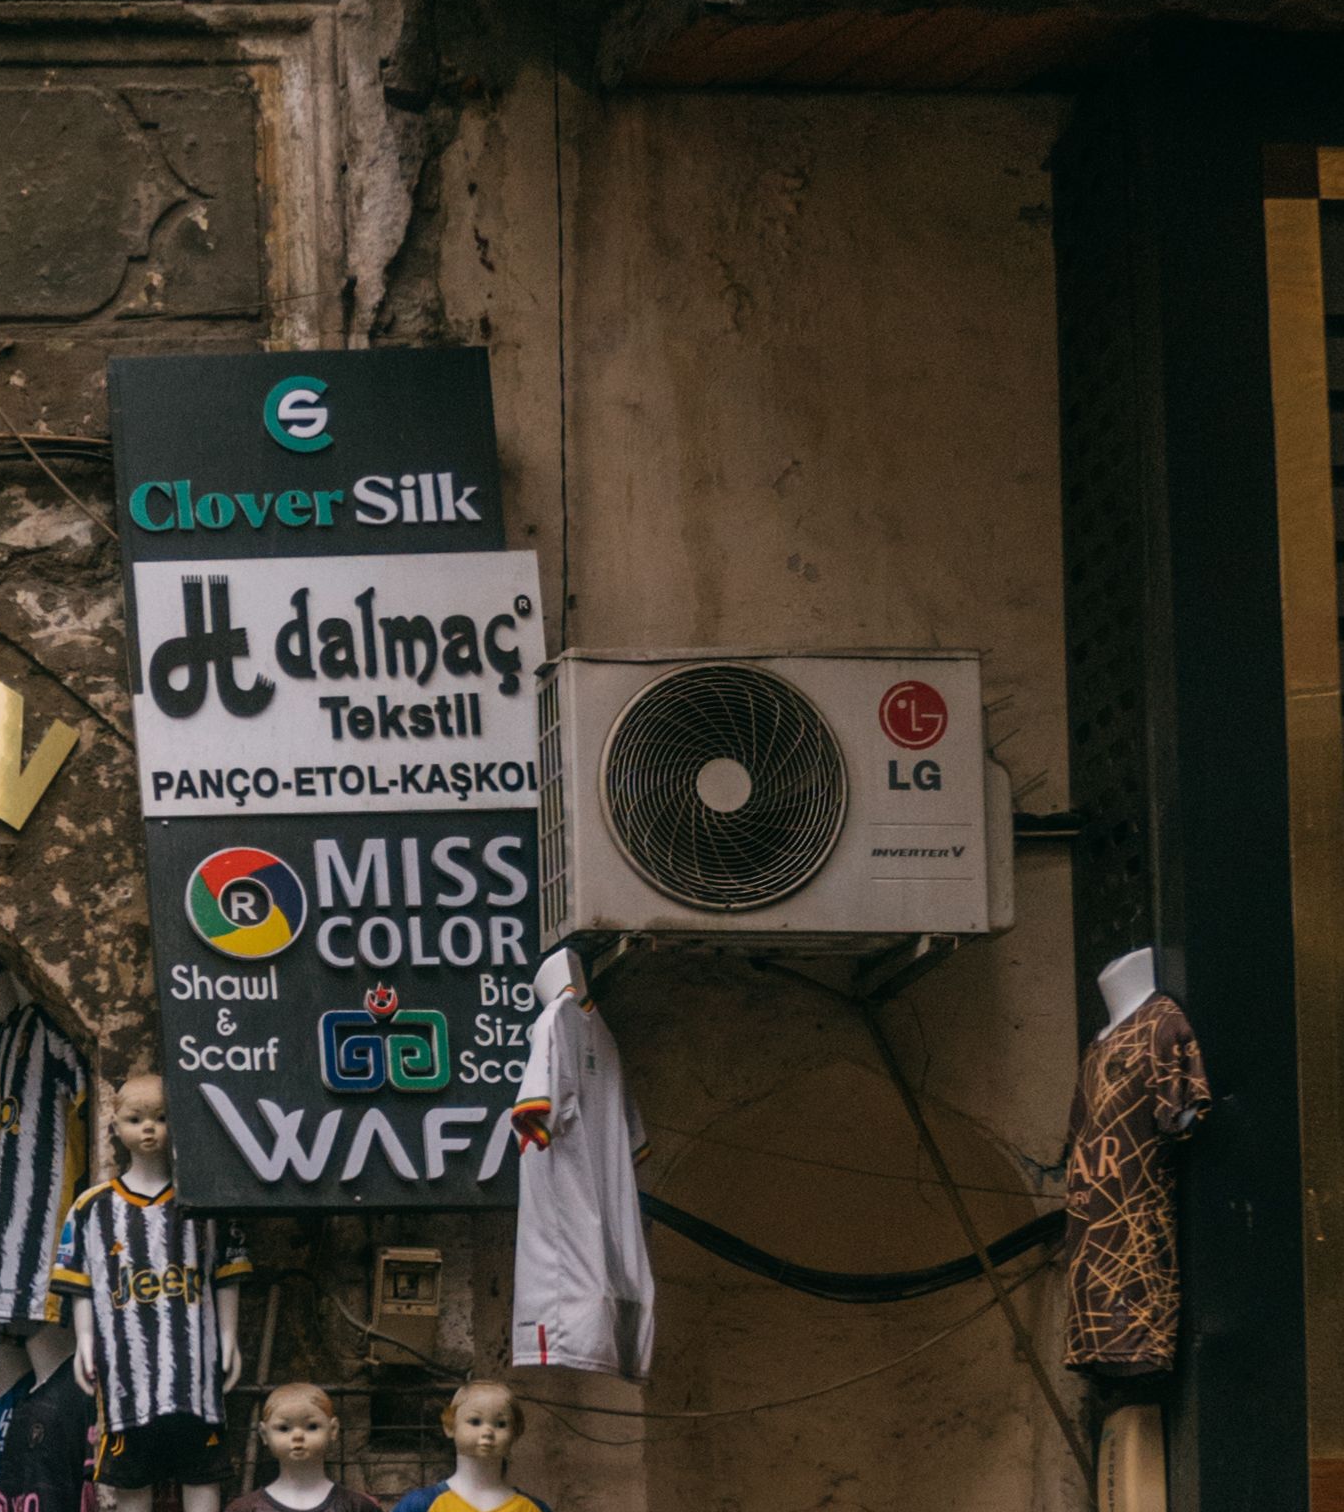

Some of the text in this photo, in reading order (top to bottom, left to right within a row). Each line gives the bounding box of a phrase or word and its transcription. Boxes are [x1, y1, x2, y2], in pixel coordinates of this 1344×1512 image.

[129, 470, 483, 533] Clover Silk
[275, 586, 525, 694] dalmaç
[319, 691, 483, 740] Tekstil
[888, 759, 942, 791] LG
[314, 835, 530, 910] MISS
[871, 846, 965, 859] INVERTER V
[314, 915, 528, 970] COLOR
[170, 964, 280, 1002] Shawl
[479, 973, 536, 1013] Big
[214, 1007, 238, 1035] &
[178, 1035, 280, 1072] Scarf
